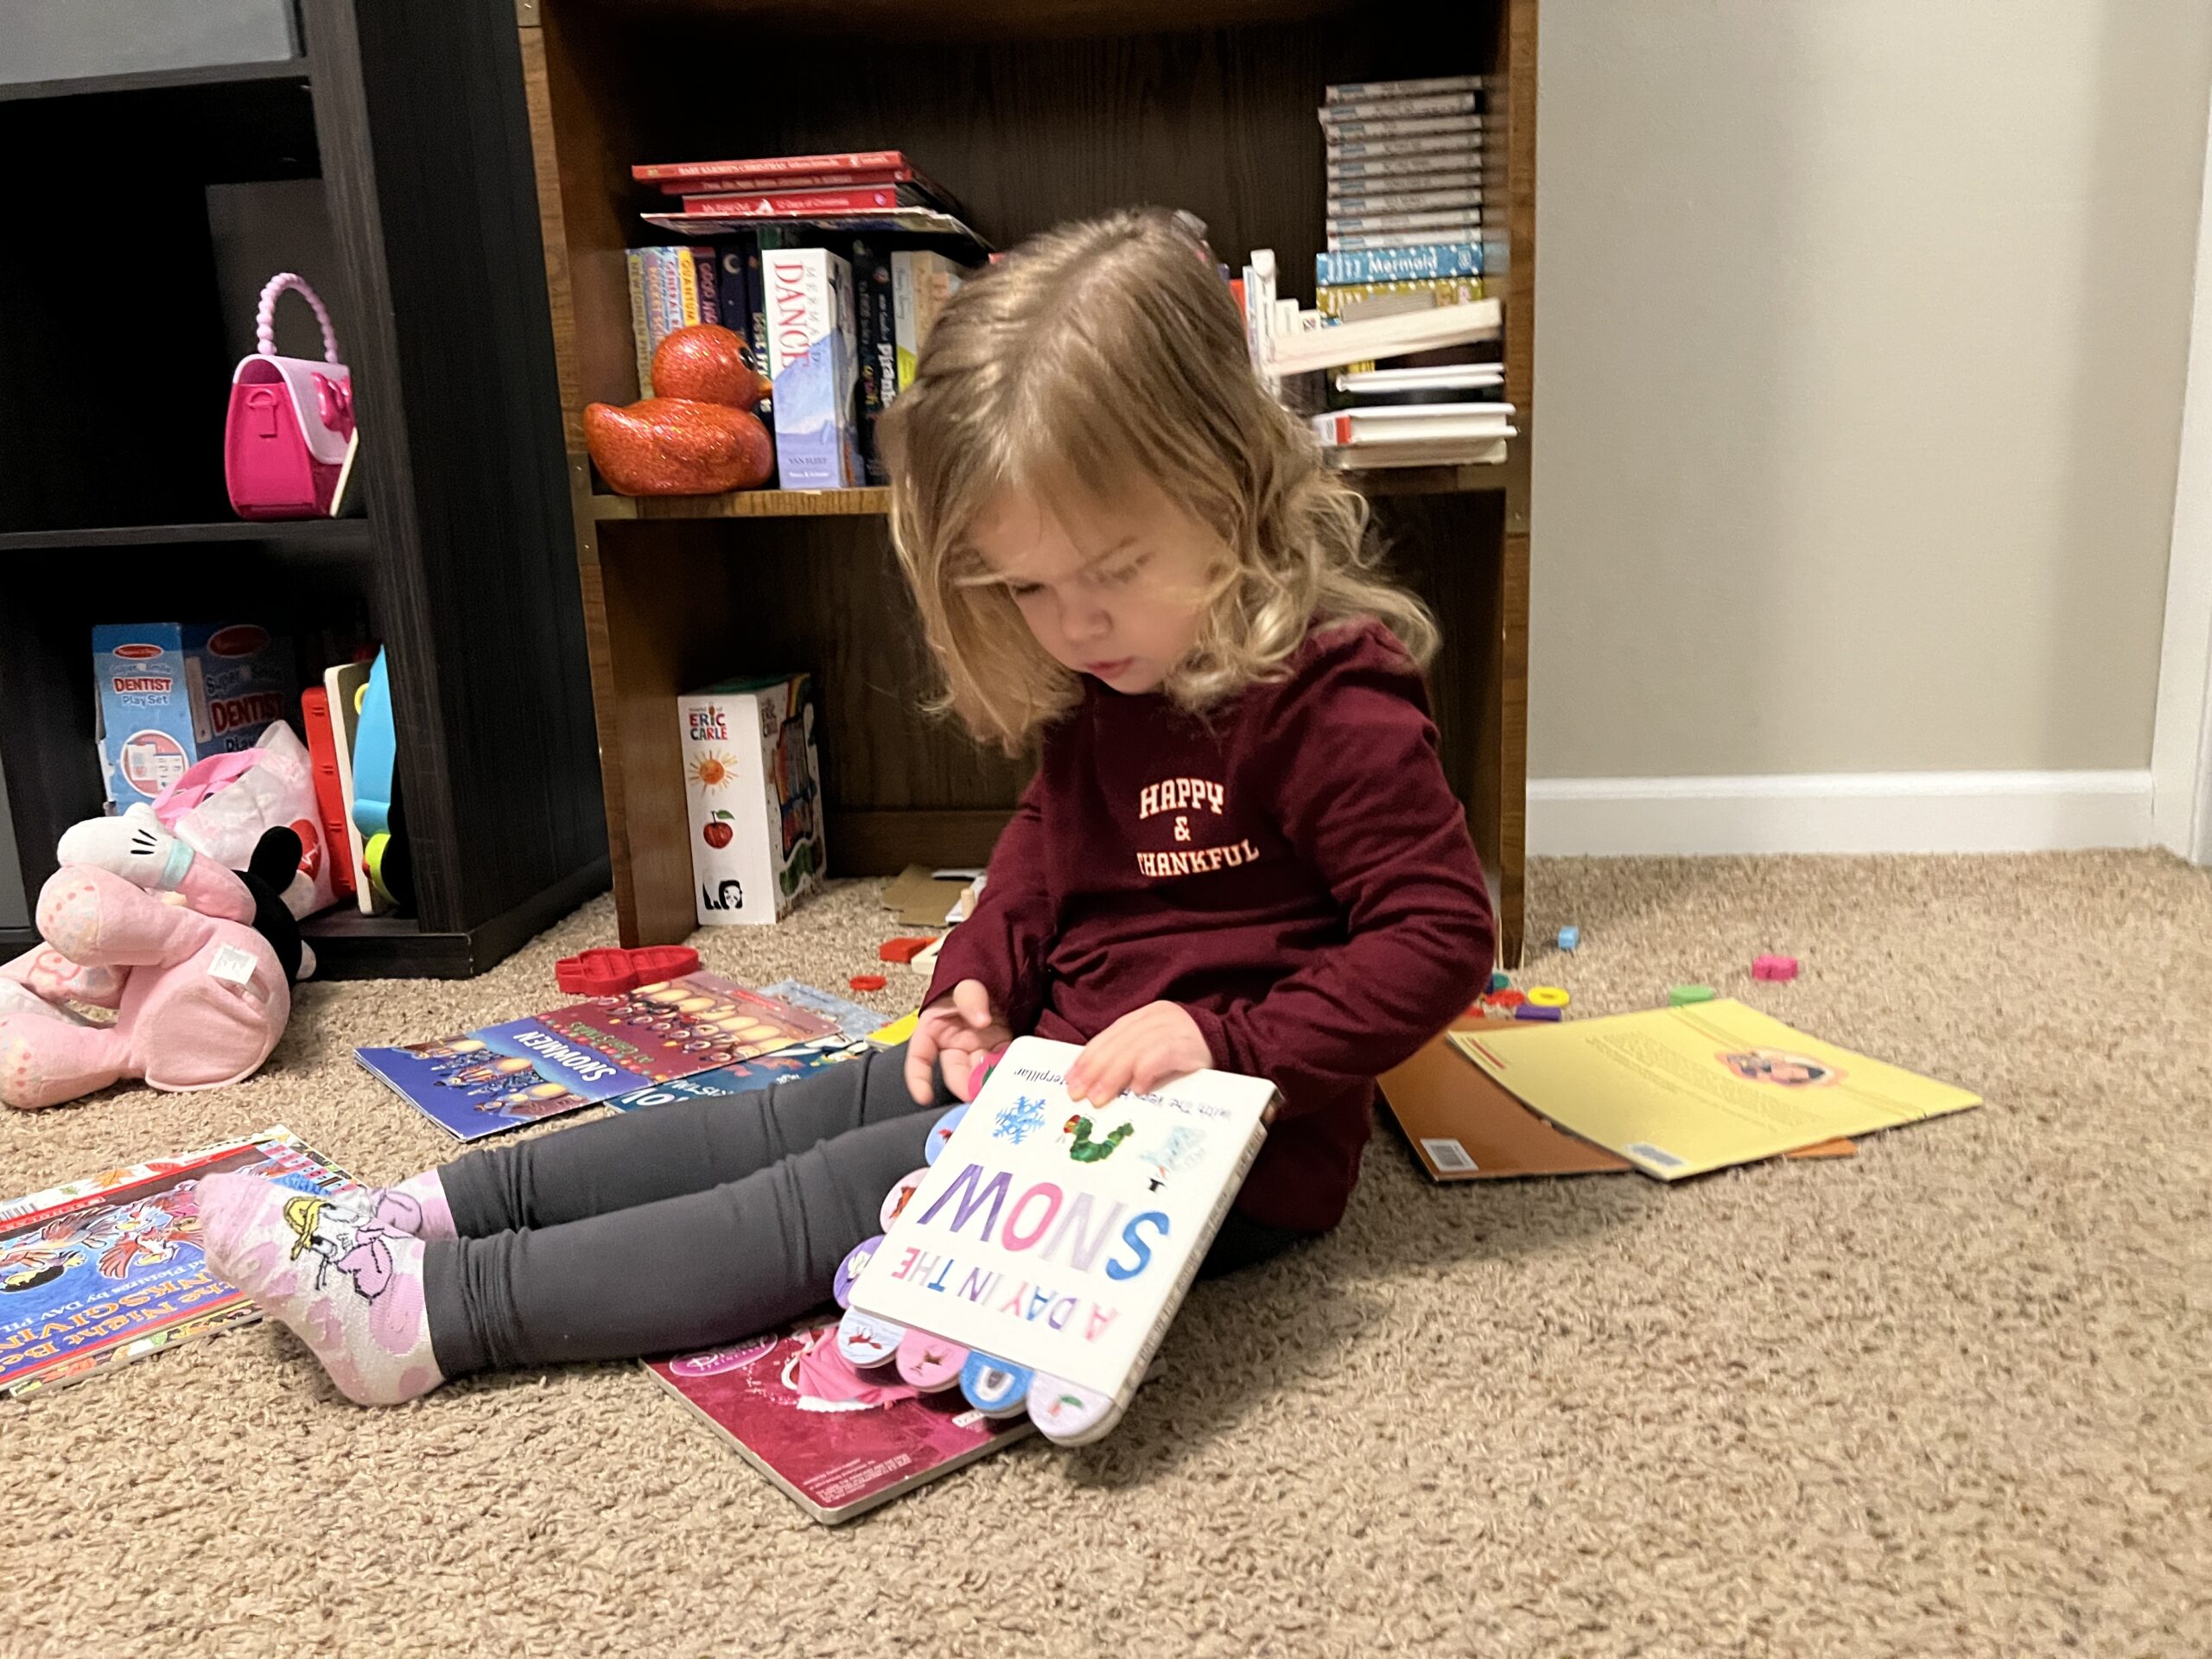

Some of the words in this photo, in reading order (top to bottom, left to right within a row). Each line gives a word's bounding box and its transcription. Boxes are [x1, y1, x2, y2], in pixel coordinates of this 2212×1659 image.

[679, 258, 697, 321] QUANTUM
[774, 263, 810, 366] DANCE
[114, 677, 172, 693] DENTIST
[122, 695, 146, 708] Play
[147, 694, 169, 705] Set
[211, 694, 283, 734] DENTIST
[690, 711, 726, 728] ERIC
[690, 728, 728, 741] CARLE
[1139, 778, 1224, 819] HAPPY
[1174, 816, 1192, 842] &
[512, 1028, 619, 1083] SNOWMEN
[1013, 1065, 1069, 1088] terpillar
[916, 1162, 1170, 1281] SNOW
[891, 1246, 955, 1294] THE
[957, 1267, 1005, 1303] IN
[0, 1271, 213, 1352] NKSGIVIN
[64, 1300, 178, 1346] Night
[999, 1280, 1077, 1332] DAY
[1083, 1298, 1122, 1342] A
